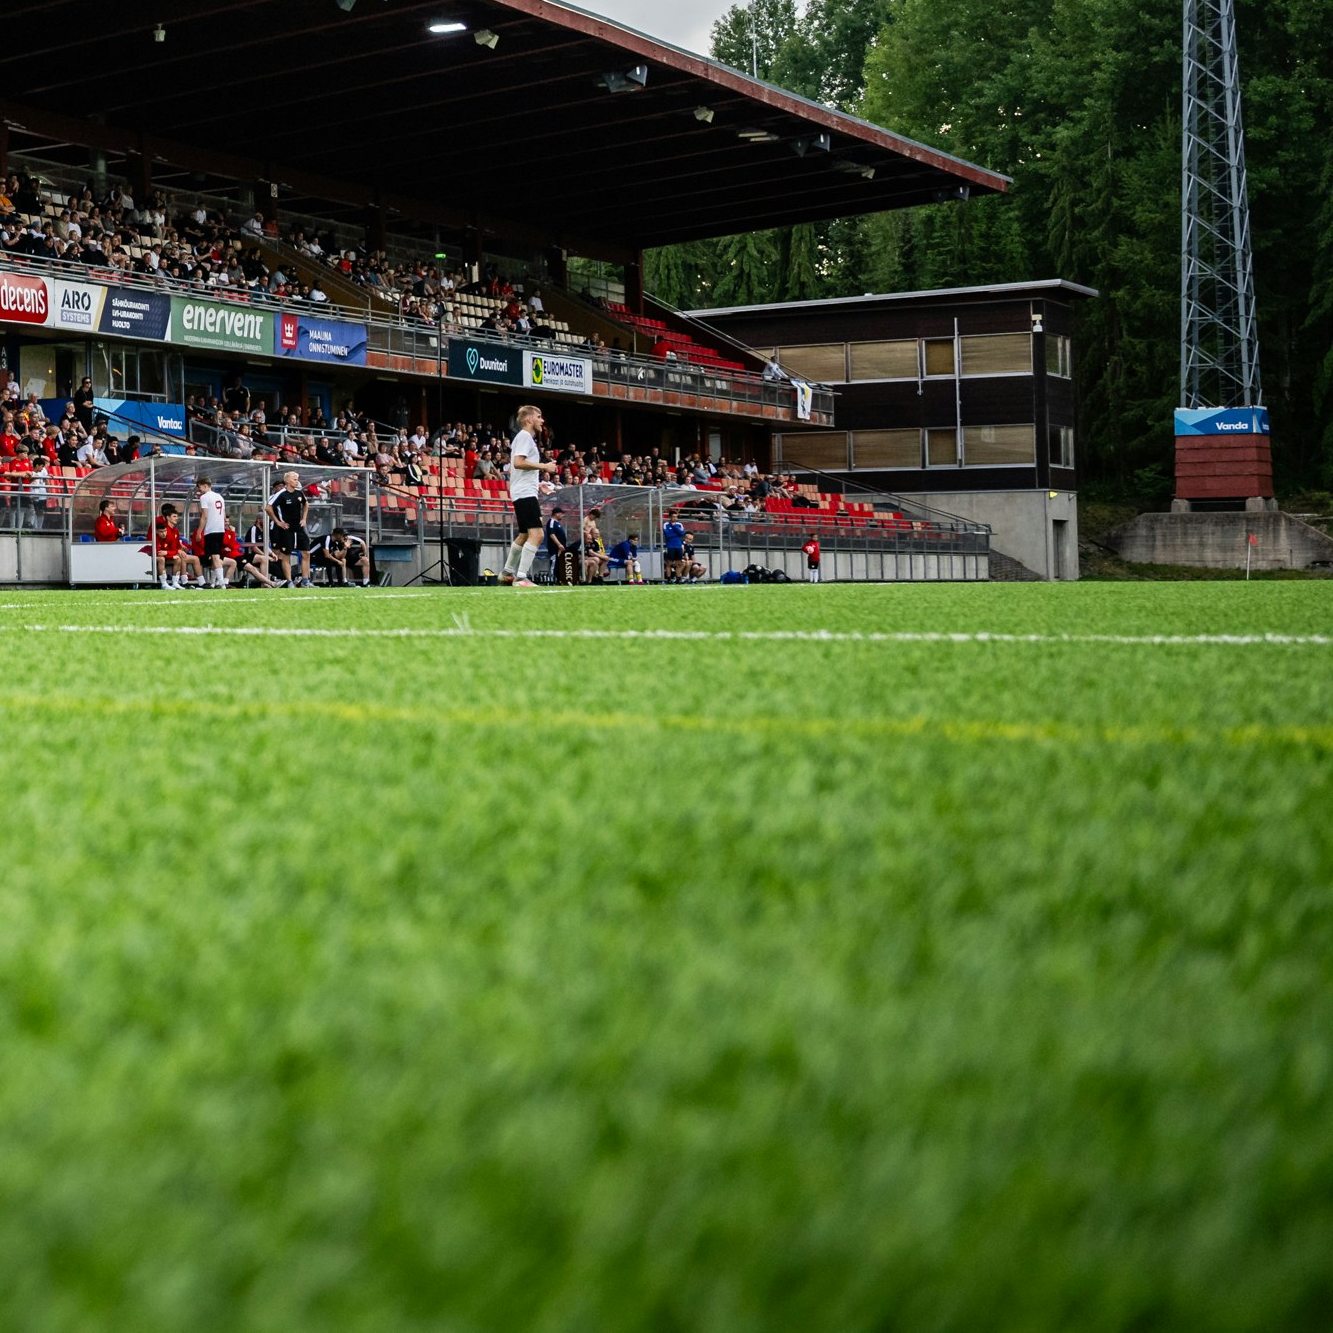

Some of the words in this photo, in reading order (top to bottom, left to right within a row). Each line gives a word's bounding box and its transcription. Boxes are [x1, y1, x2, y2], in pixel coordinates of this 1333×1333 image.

[0, 278, 46, 314] decens
[61, 289, 92, 311] ARO
[62, 312, 90, 323] SYSTEMS
[112, 320, 131, 329] HUOLTO
[182, 304, 264, 340] enervent
[1, 346, 7, 357] A
[1, 358, 7, 369] 3
[479, 357, 508, 372] Duunitori
[543, 360, 583, 378] EUROMASTER
[157, 416, 183, 430] Vantaa
[1215, 421, 1249, 430] Vanda
[215, 500, 223, 515] 9
[565, 552, 573, 580] CLASSIC
